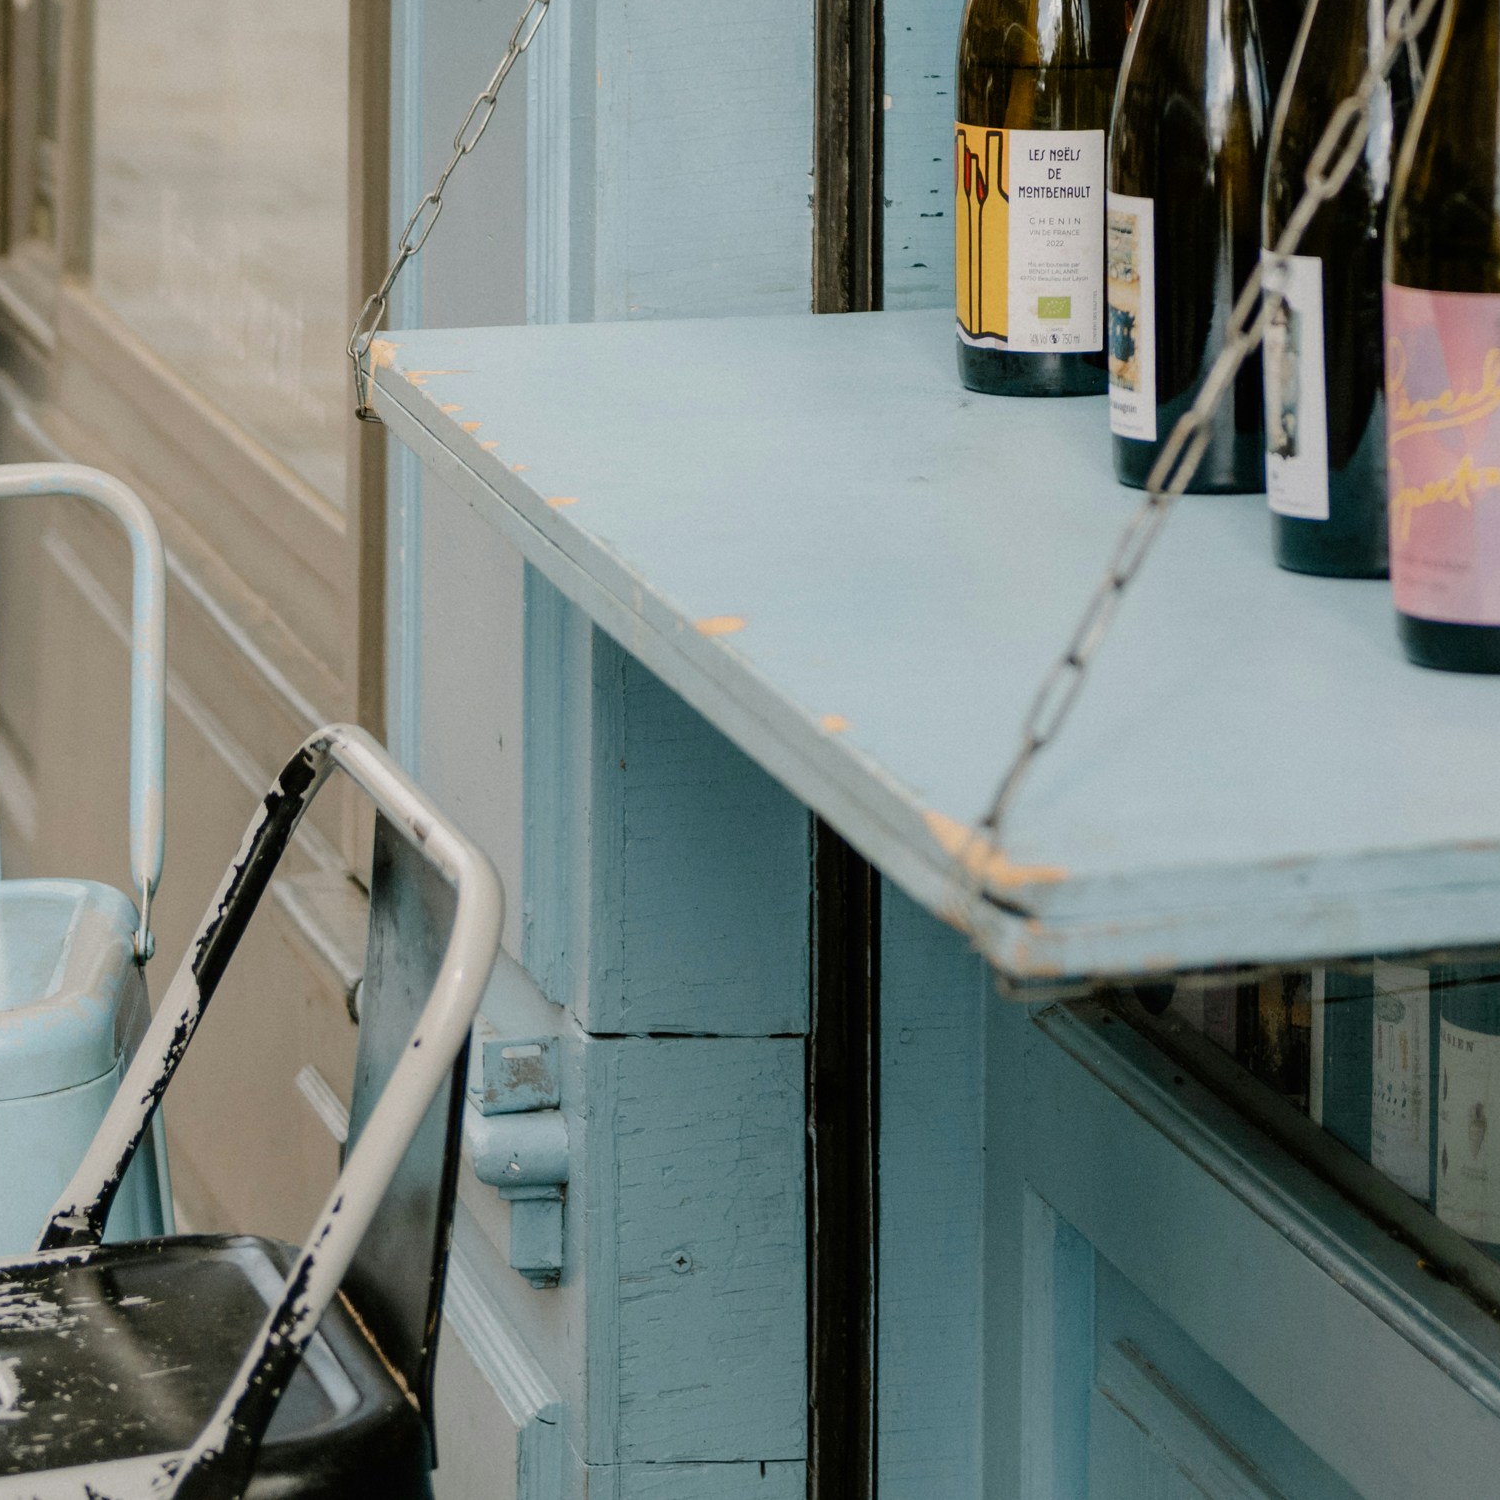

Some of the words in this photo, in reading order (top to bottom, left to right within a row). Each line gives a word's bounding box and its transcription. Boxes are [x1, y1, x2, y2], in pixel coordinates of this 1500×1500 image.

[1028, 148, 1046, 161] LES
[1047, 168, 1062, 180] DE
[1018, 185, 1091, 199] MONTBENAULT
[1029, 217, 1081, 225] CHENIN
[1046, 239, 1064, 247] 2022
